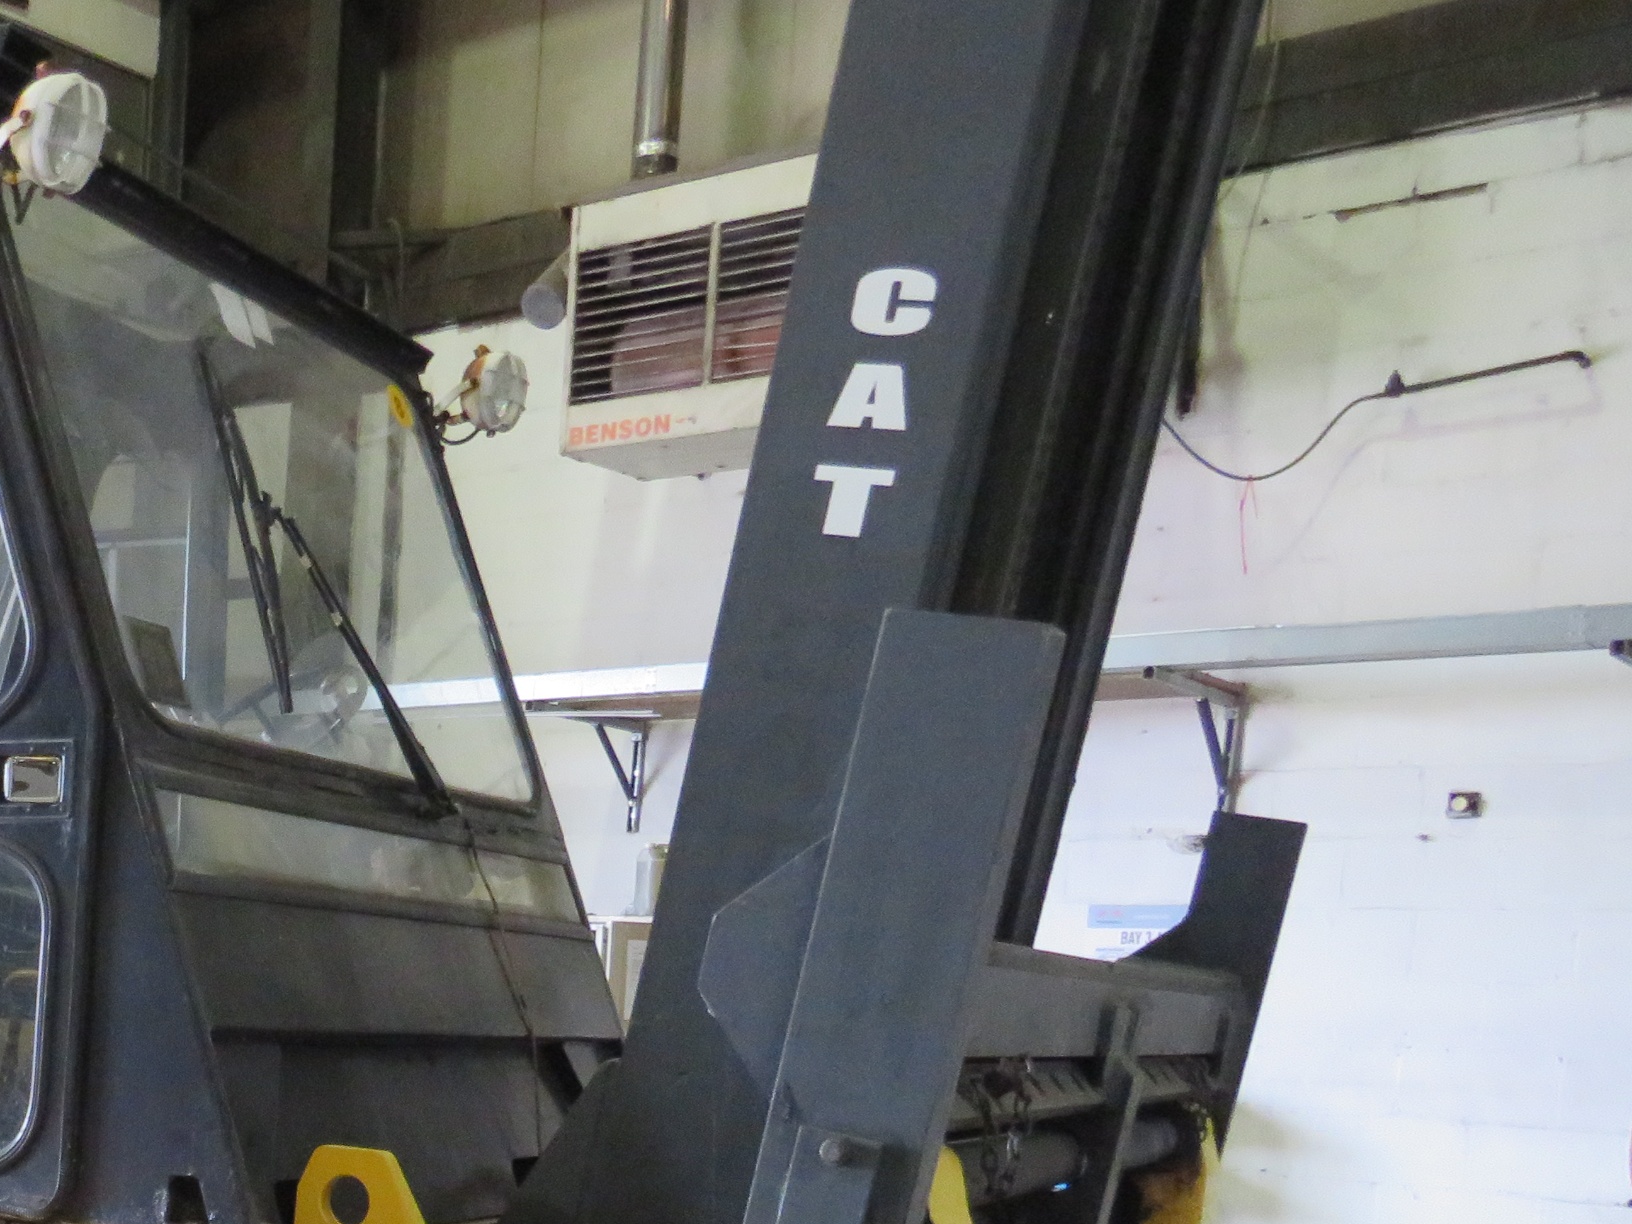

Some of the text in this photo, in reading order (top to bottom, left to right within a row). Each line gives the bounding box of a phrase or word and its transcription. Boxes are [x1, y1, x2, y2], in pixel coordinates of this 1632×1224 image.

[815, 268, 938, 538] CAT
[569, 414, 672, 446] BENSON
[1120, 931, 1142, 945] BAY
